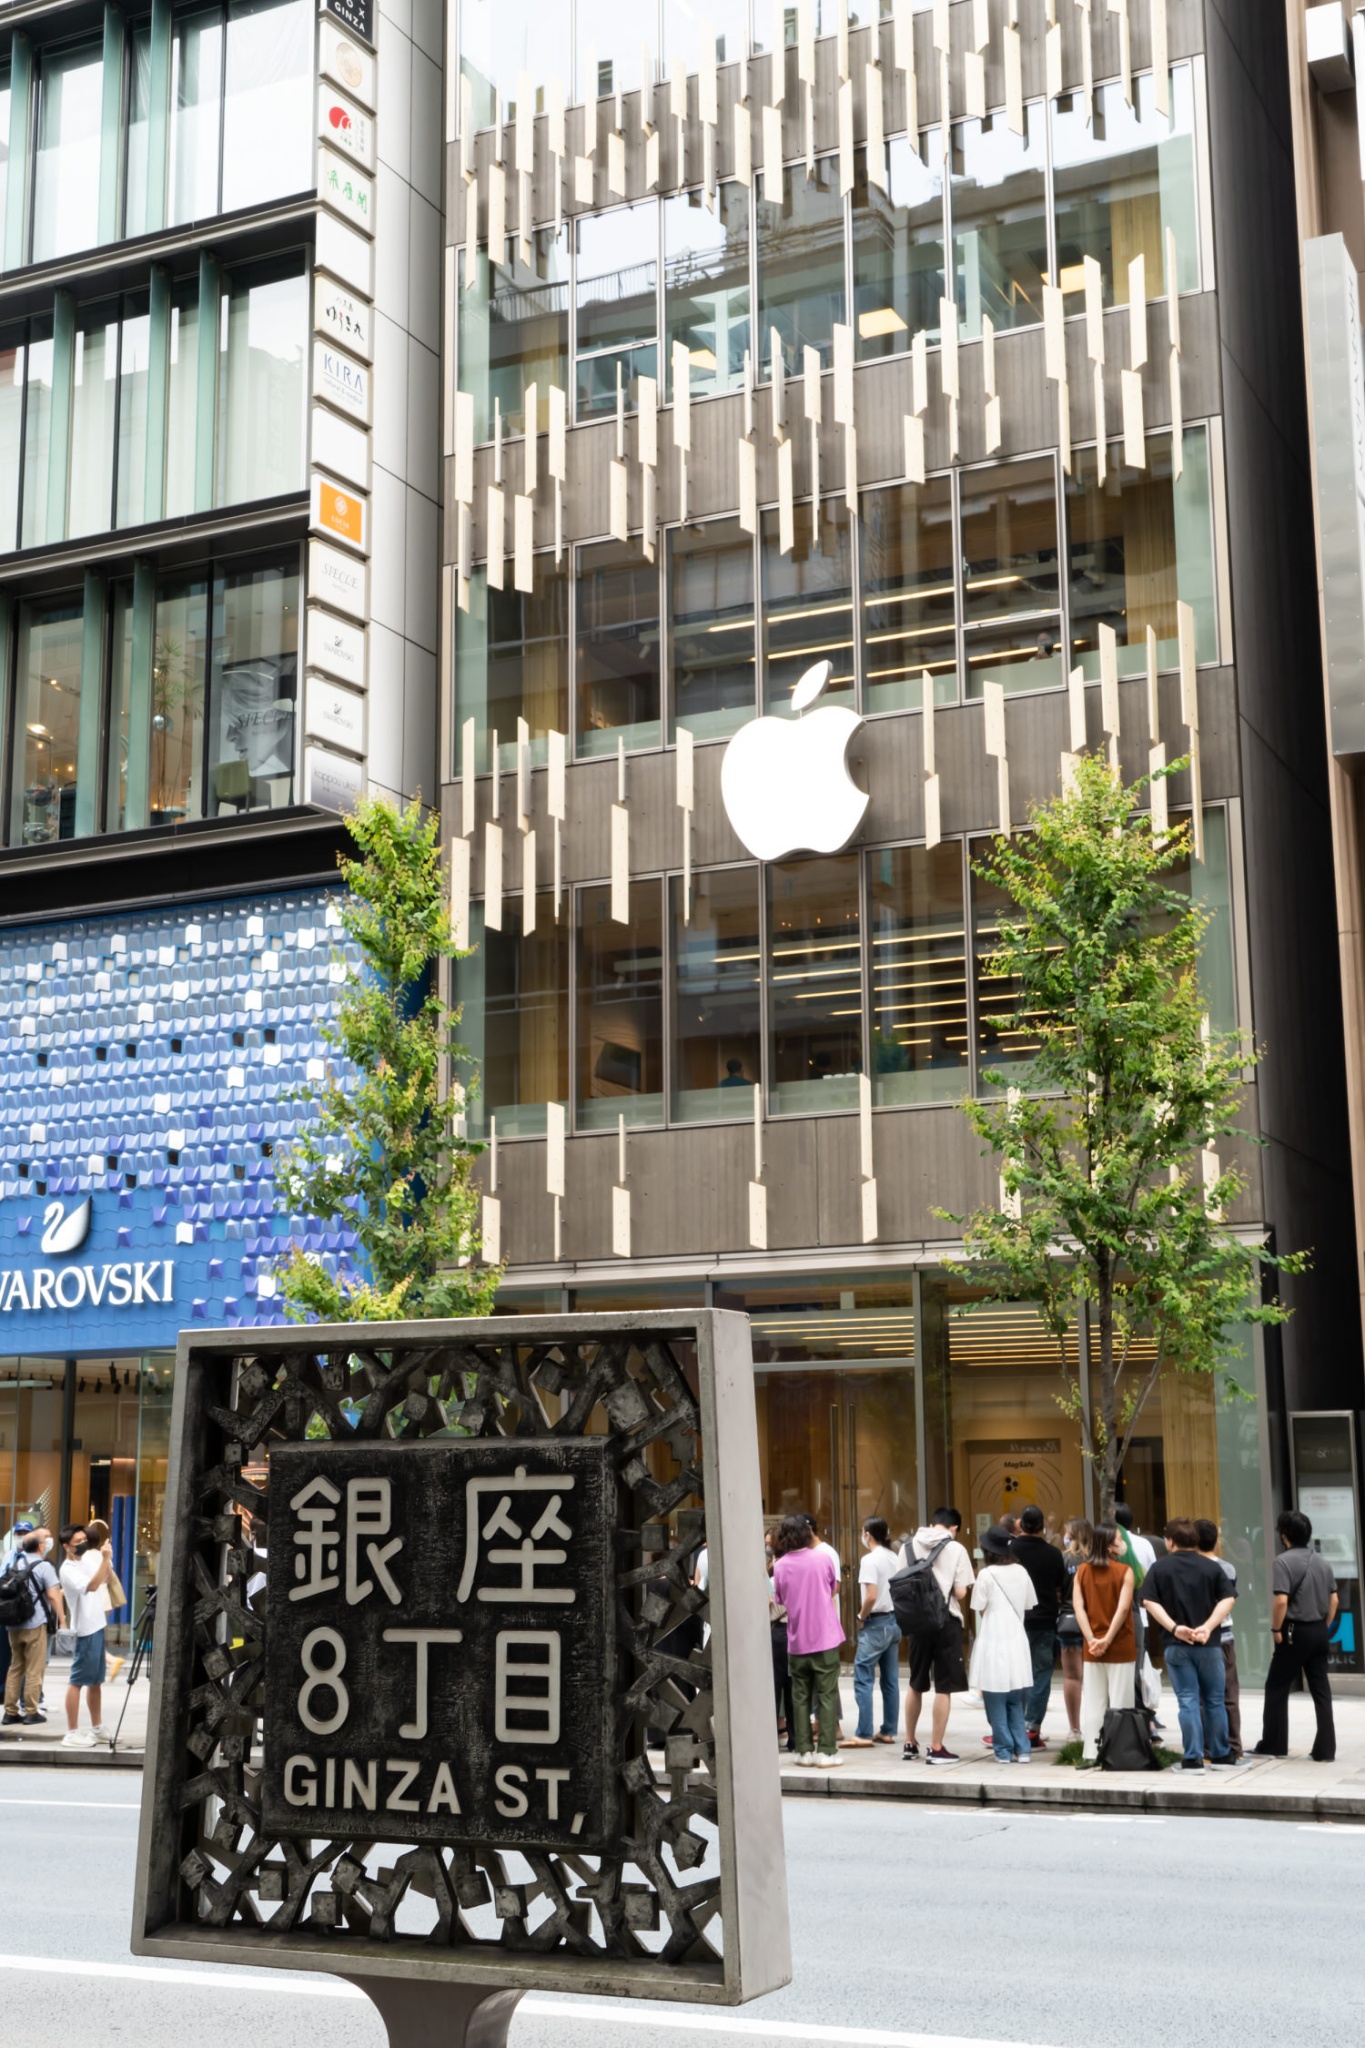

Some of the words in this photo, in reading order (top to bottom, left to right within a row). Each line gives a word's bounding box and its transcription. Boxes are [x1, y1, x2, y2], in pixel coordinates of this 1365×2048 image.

[334, 1, 366, 33] GINZA
[324, 353, 363, 393] KIRA
[1004, 1460, 1035, 1470] MagSafe
[288, 1464, 577, 1606] 銀座
[297, 1626, 562, 1745] 8丁目
[284, 1753, 463, 1816] GINZA
